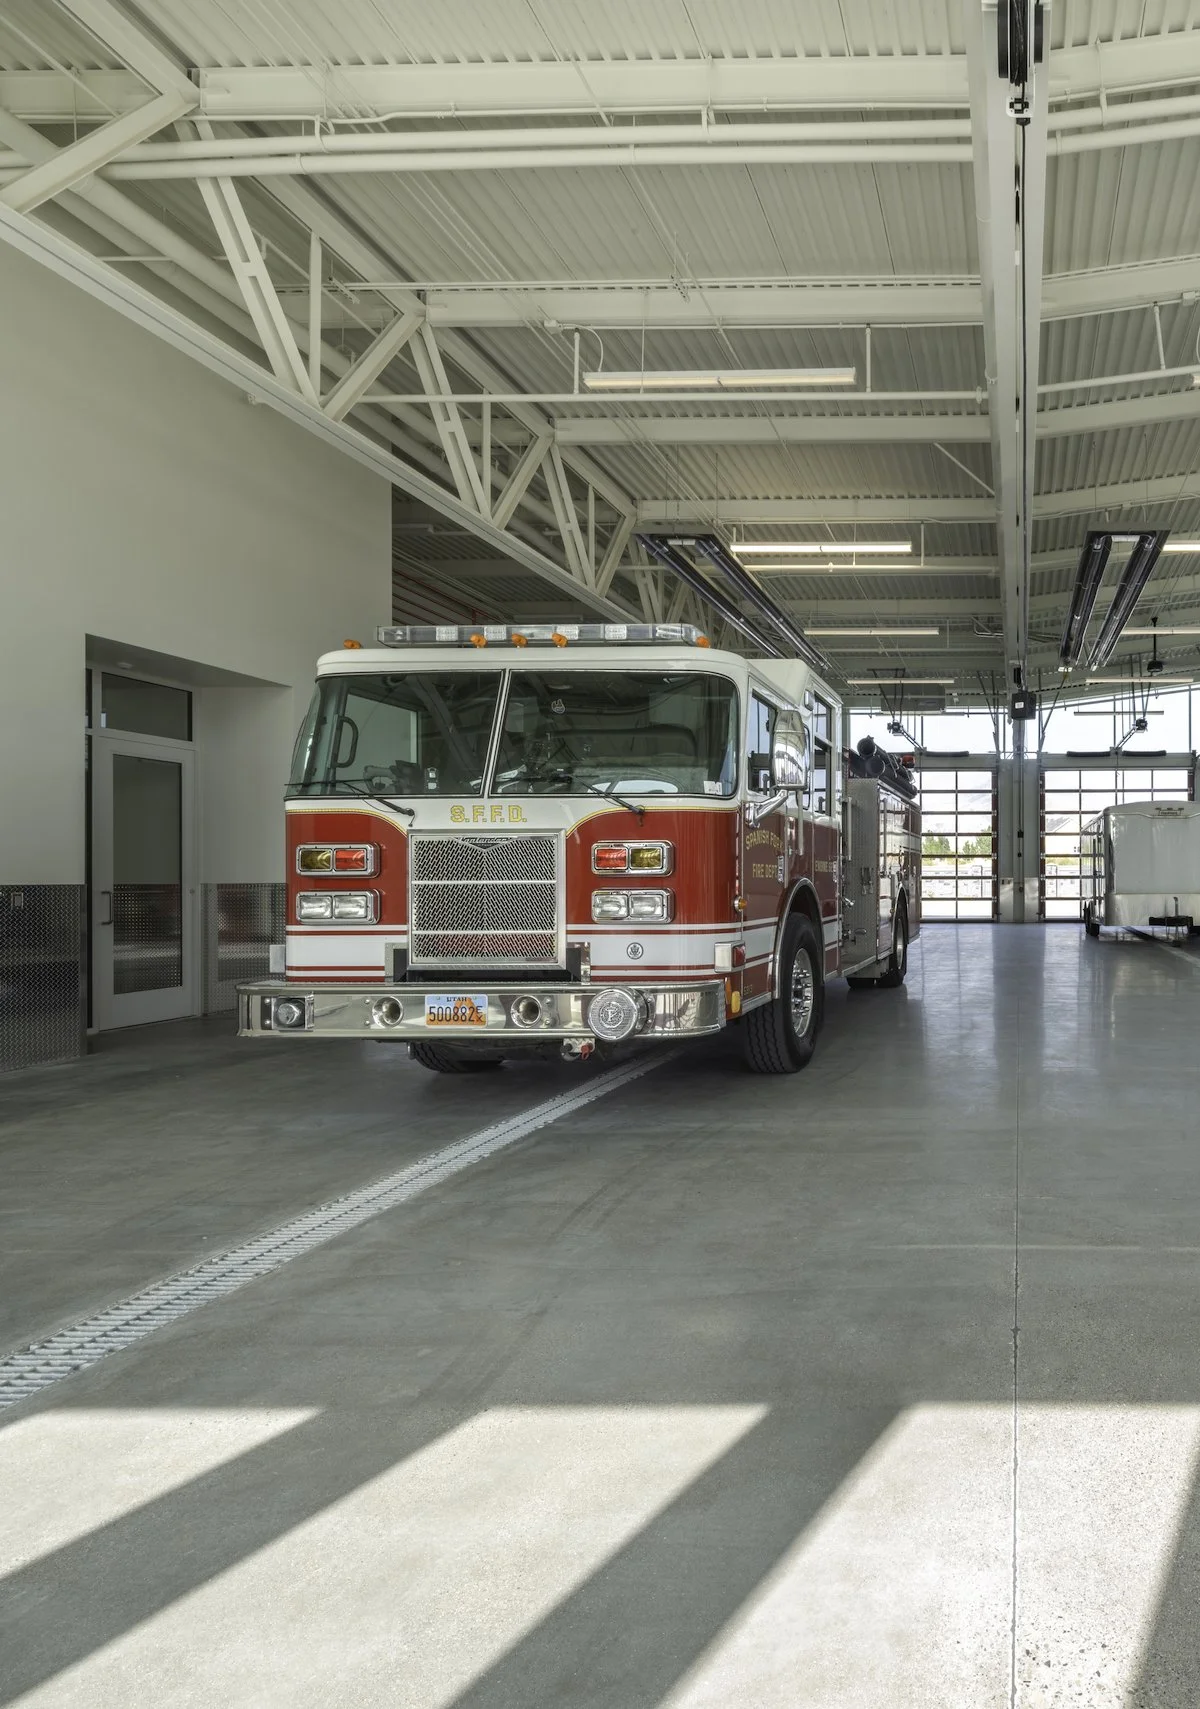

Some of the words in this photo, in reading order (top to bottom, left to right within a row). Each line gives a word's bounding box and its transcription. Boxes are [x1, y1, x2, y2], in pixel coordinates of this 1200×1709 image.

[450, 805, 528, 823] S.F.F.D.
[745, 830, 770, 850] SPANISH
[752, 863, 765, 878] FIRE
